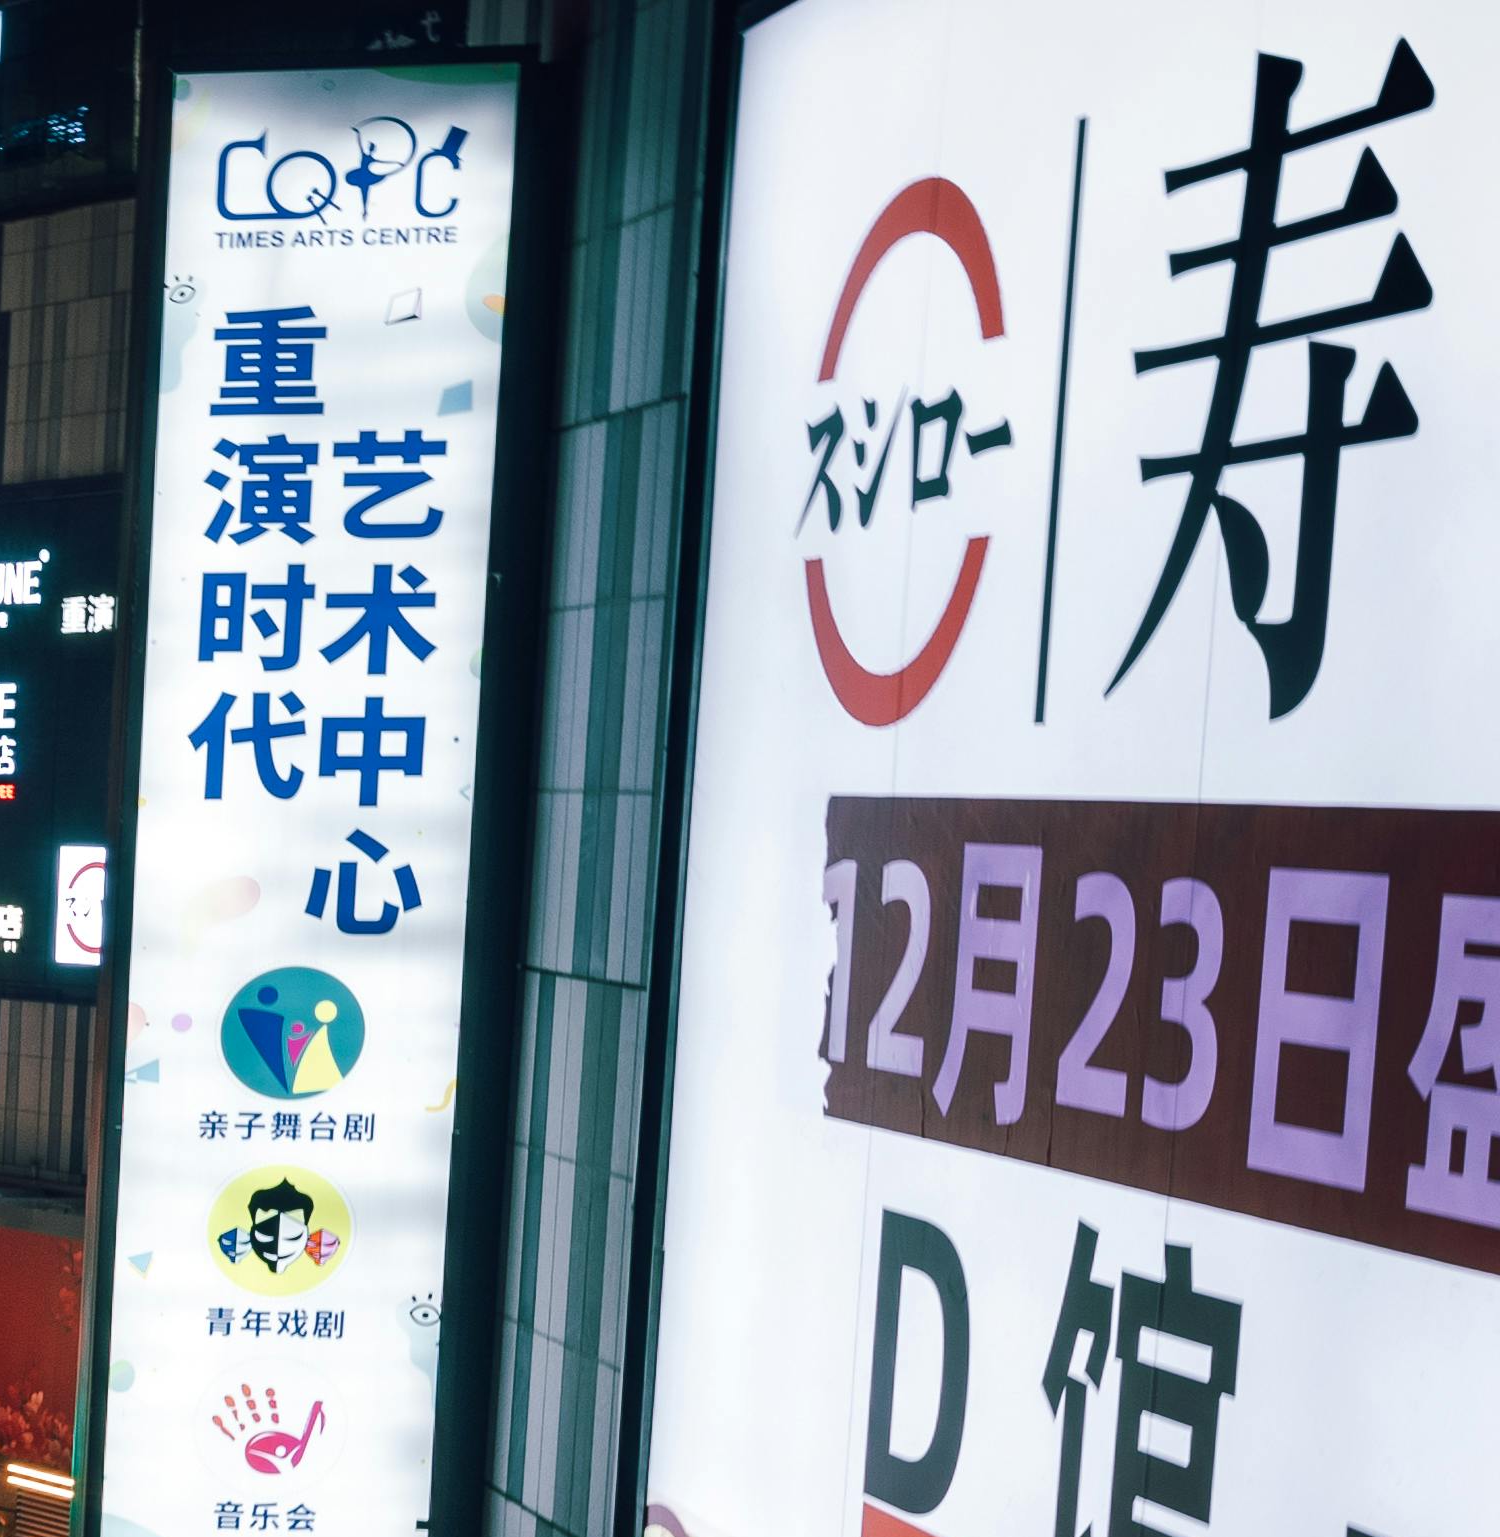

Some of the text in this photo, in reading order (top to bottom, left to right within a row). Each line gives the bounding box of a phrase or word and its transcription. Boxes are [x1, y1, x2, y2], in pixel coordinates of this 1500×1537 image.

[215, 225, 459, 250] TIMES ARTS CENTRE
[1103, 34, 1436, 721] 寿
[795, 386, 1012, 538] スシロー
[189, 305, 328, 801] 重演时代
[61, 593, 118, 634] 重演
[305, 429, 448, 936] 艺术中心
[198, 1109, 377, 1143] 亲子舞台剧
[205, 1307, 346, 1341] 青年戏剧
[213, 1502, 317, 1534] 音乐会
